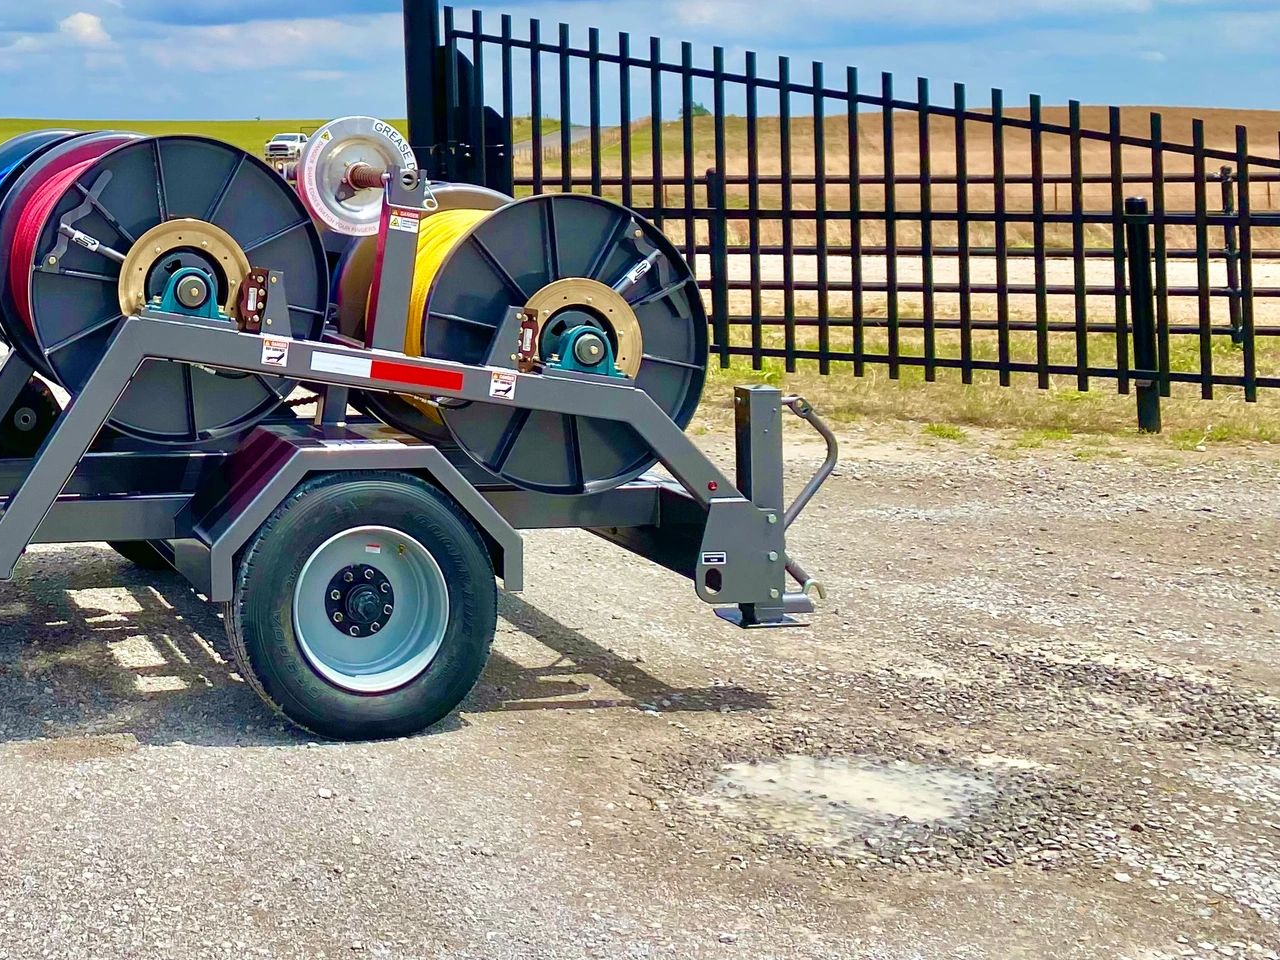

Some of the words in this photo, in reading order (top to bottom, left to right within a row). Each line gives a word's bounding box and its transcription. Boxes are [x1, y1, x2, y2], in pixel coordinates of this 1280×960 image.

[374, 122, 413, 160] GREASE
[308, 187, 320, 209] EDGES
[318, 206, 335, 224] WATCH
[334, 220, 351, 232] YOUR
[349, 224, 377, 234] FINGERS
[400, 210, 419, 219] DANGER
